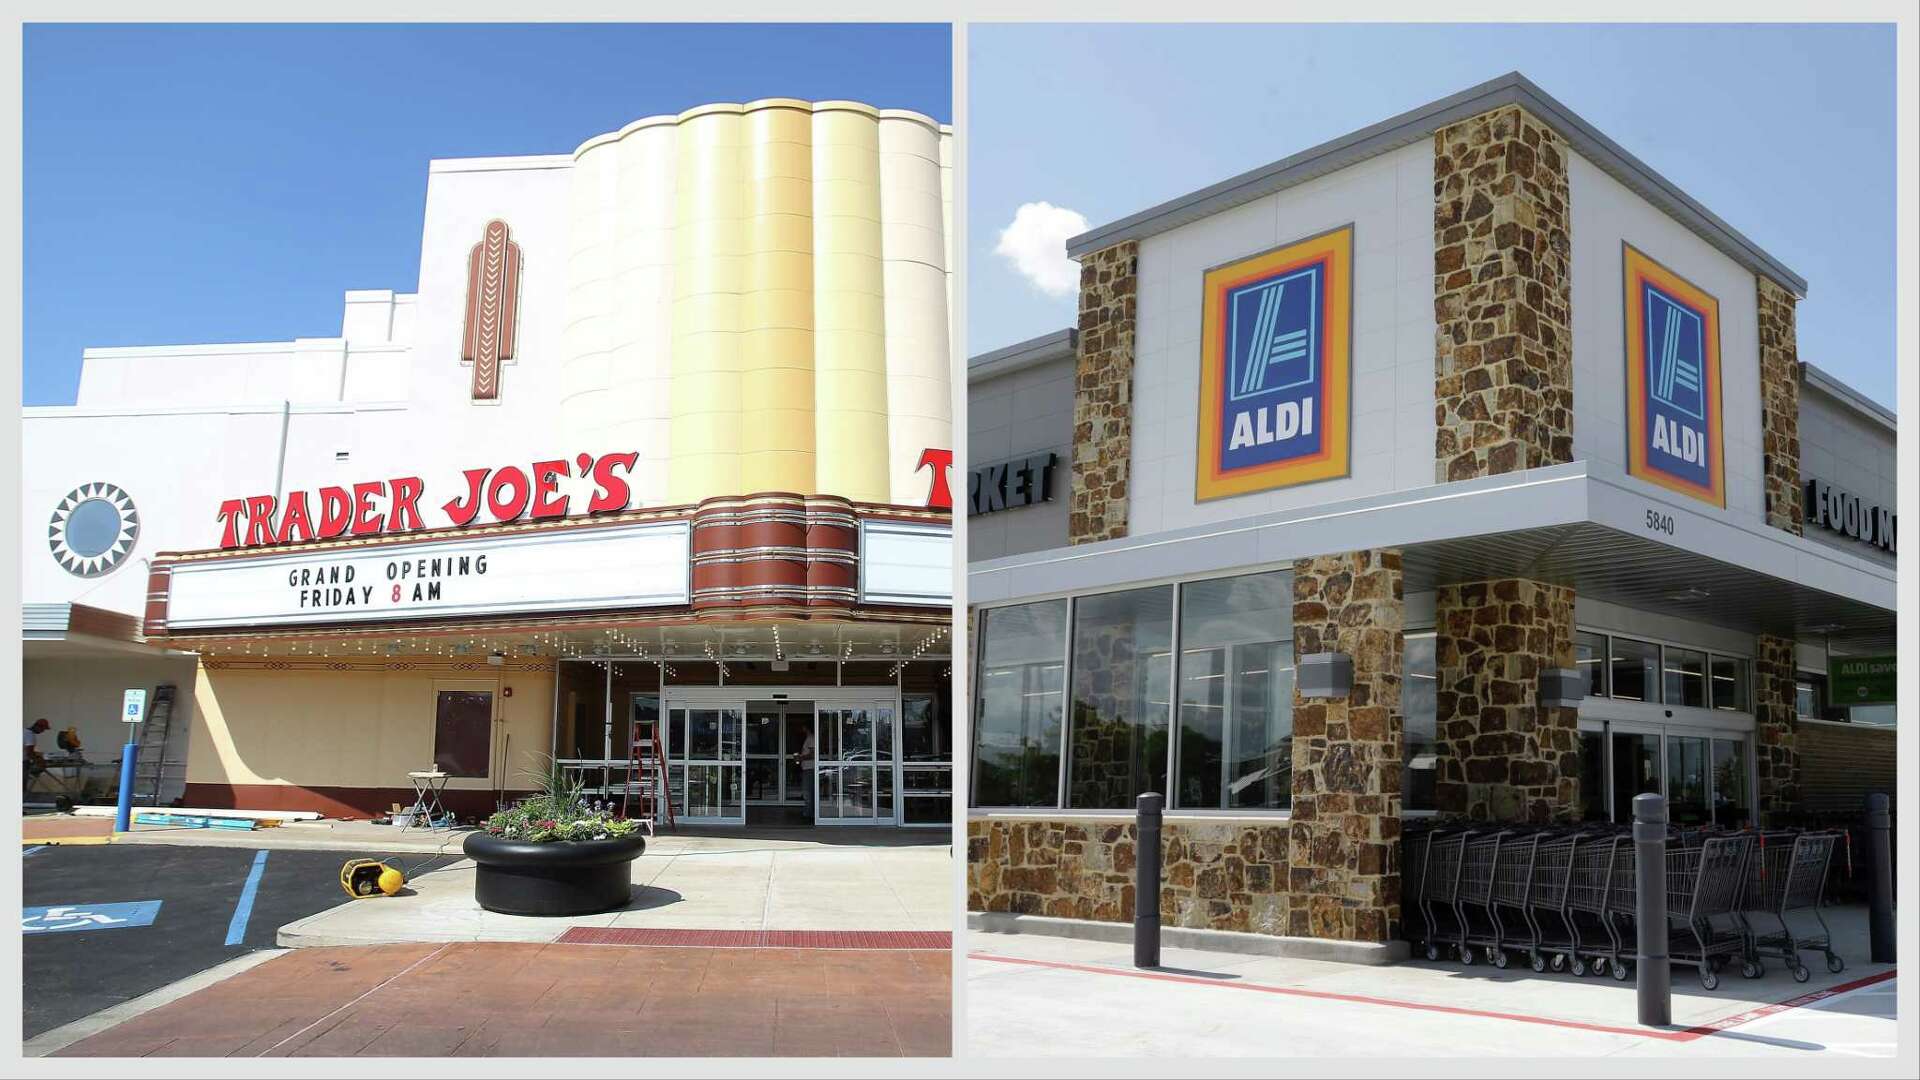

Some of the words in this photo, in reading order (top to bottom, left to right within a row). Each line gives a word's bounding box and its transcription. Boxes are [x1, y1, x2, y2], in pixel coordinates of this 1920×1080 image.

[1229, 396, 1314, 451] ALDI
[1652, 413, 1706, 468] ALDI
[216, 476, 426, 550] TRADER
[441, 451, 640, 527] JOE'S
[1646, 509, 1674, 536] 5840
[1807, 480, 1873, 543] FOOD
[289, 565, 355, 587] GRAND
[386, 554, 488, 580] OPENING
[300, 586, 373, 608] FRIDAY
[391, 584, 401, 603] 8
[412, 581, 441, 602] AM
[1841, 662, 1869, 675] ALDI
